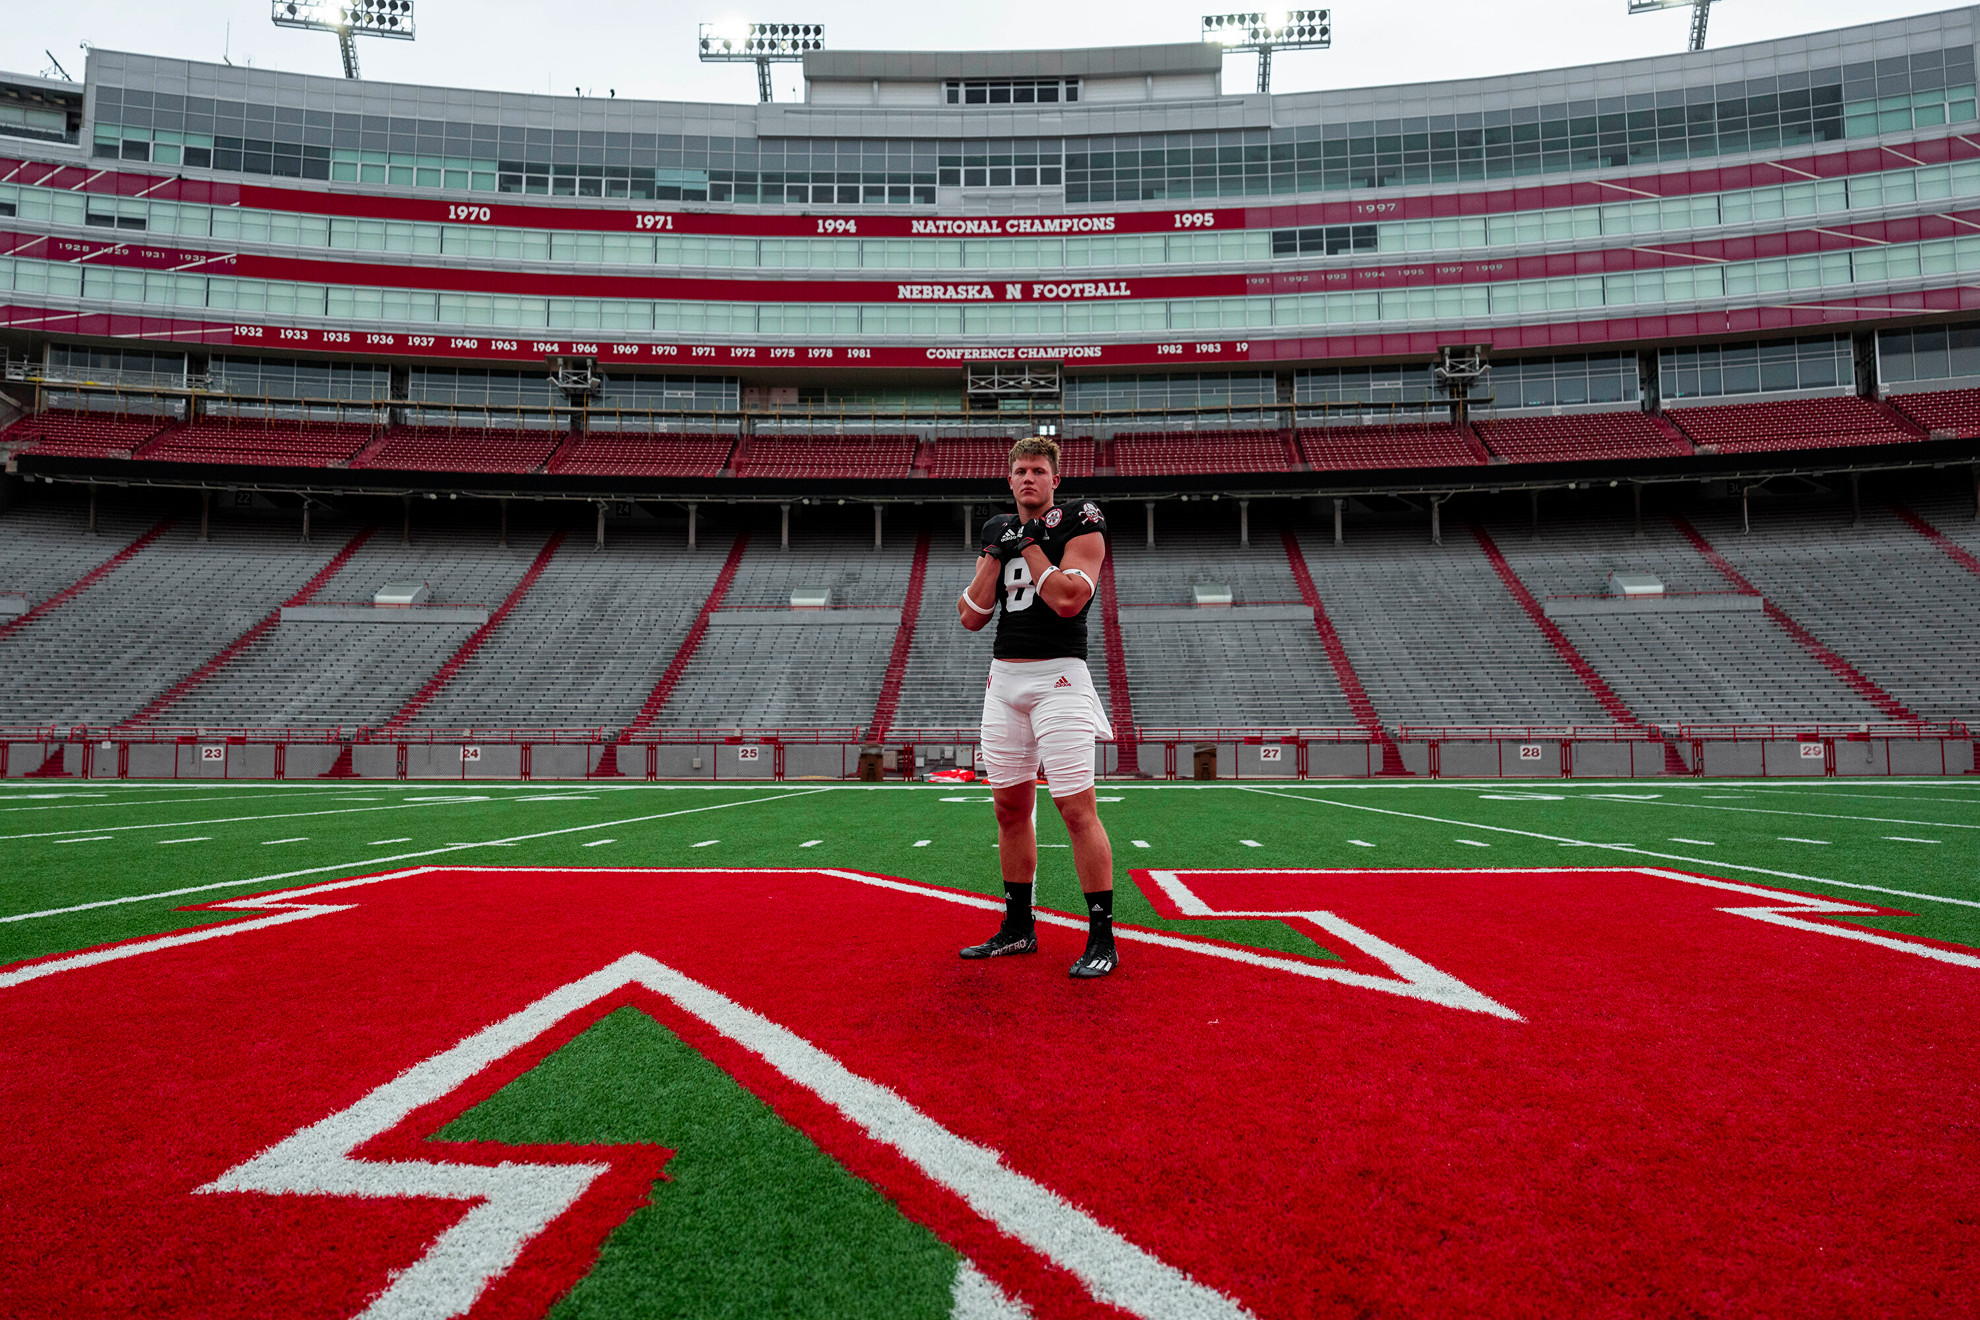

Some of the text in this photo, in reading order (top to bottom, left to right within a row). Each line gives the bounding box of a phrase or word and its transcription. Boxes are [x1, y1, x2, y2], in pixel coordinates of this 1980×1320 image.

[1357, 203, 1396, 213] 1997
[449, 205, 1215, 234] 1970 1971 1994 NATIONAL CHAMPIONS 1995
[58, 243, 90, 252] 1928
[1359, 271, 1385, 279] 1994
[897, 283, 1130, 299] NEBRASKA N FOOTBALL
[234, 326, 263, 337] 1932
[279, 329, 308, 341] 1933
[323, 331, 350, 343] 1935
[366, 334, 394, 345] 1936
[408, 336, 435, 346] 1937
[450, 338, 478, 349] 1940
[491, 340, 517, 351] 1963
[533, 342, 559, 352] 1964
[572, 343, 598, 353] 1966
[613, 344, 638, 354] 1969
[651, 346, 678, 355] 1970
[692, 347, 716, 357] 1971
[730, 347, 755, 357] 1972
[770, 348, 795, 358] 1975
[808, 348, 833, 358] 1978
[847, 349, 871, 358] 1981
[926, 348, 1015, 359] CONFERENCE
[1017, 346, 1102, 357] CHAMPIONS
[1157, 344, 1183, 355] 1982
[1195, 343, 1221, 354] 1983
[976, 505, 988, 514] 26
[1004, 556, 1036, 613] 8
[204, 749, 222, 758] 23
[463, 749, 478, 758] 24
[741, 749, 757, 758] 25
[1263, 749, 1279, 758] 27
[1522, 748, 1540, 757] 28
[1802, 746, 1822, 756] 29
[976, 752, 984, 761] 2
